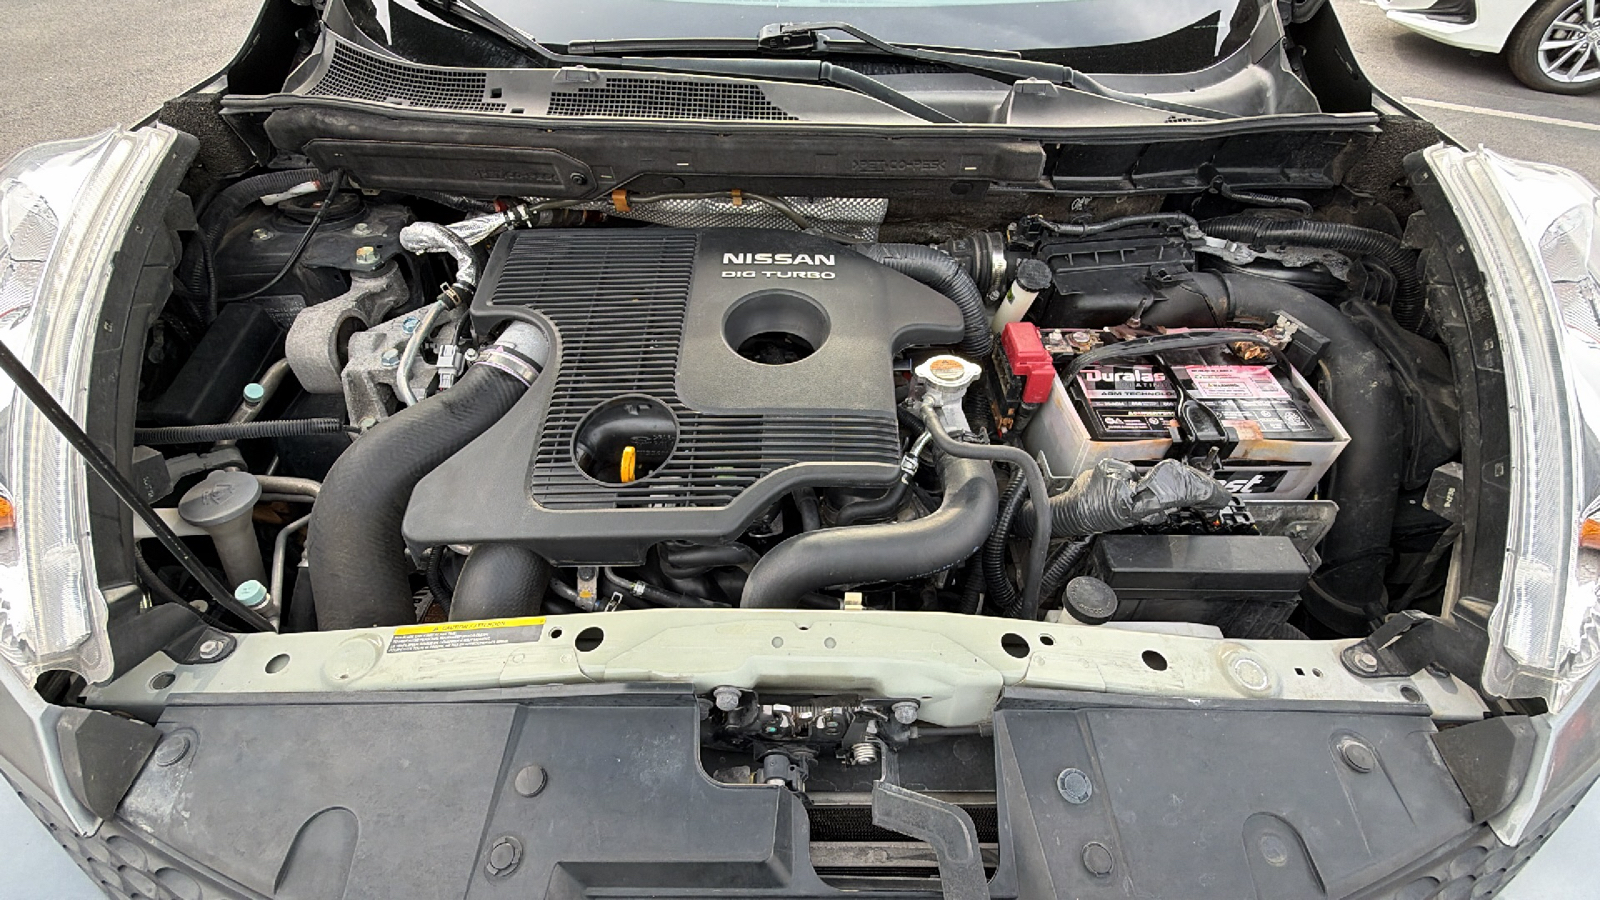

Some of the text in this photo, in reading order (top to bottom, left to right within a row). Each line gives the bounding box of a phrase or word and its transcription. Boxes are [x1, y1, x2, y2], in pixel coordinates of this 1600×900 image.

[722, 253, 835, 266] NISSAN
[761, 271, 836, 279] TURBO
[1080, 369, 1166, 382] Duralas
